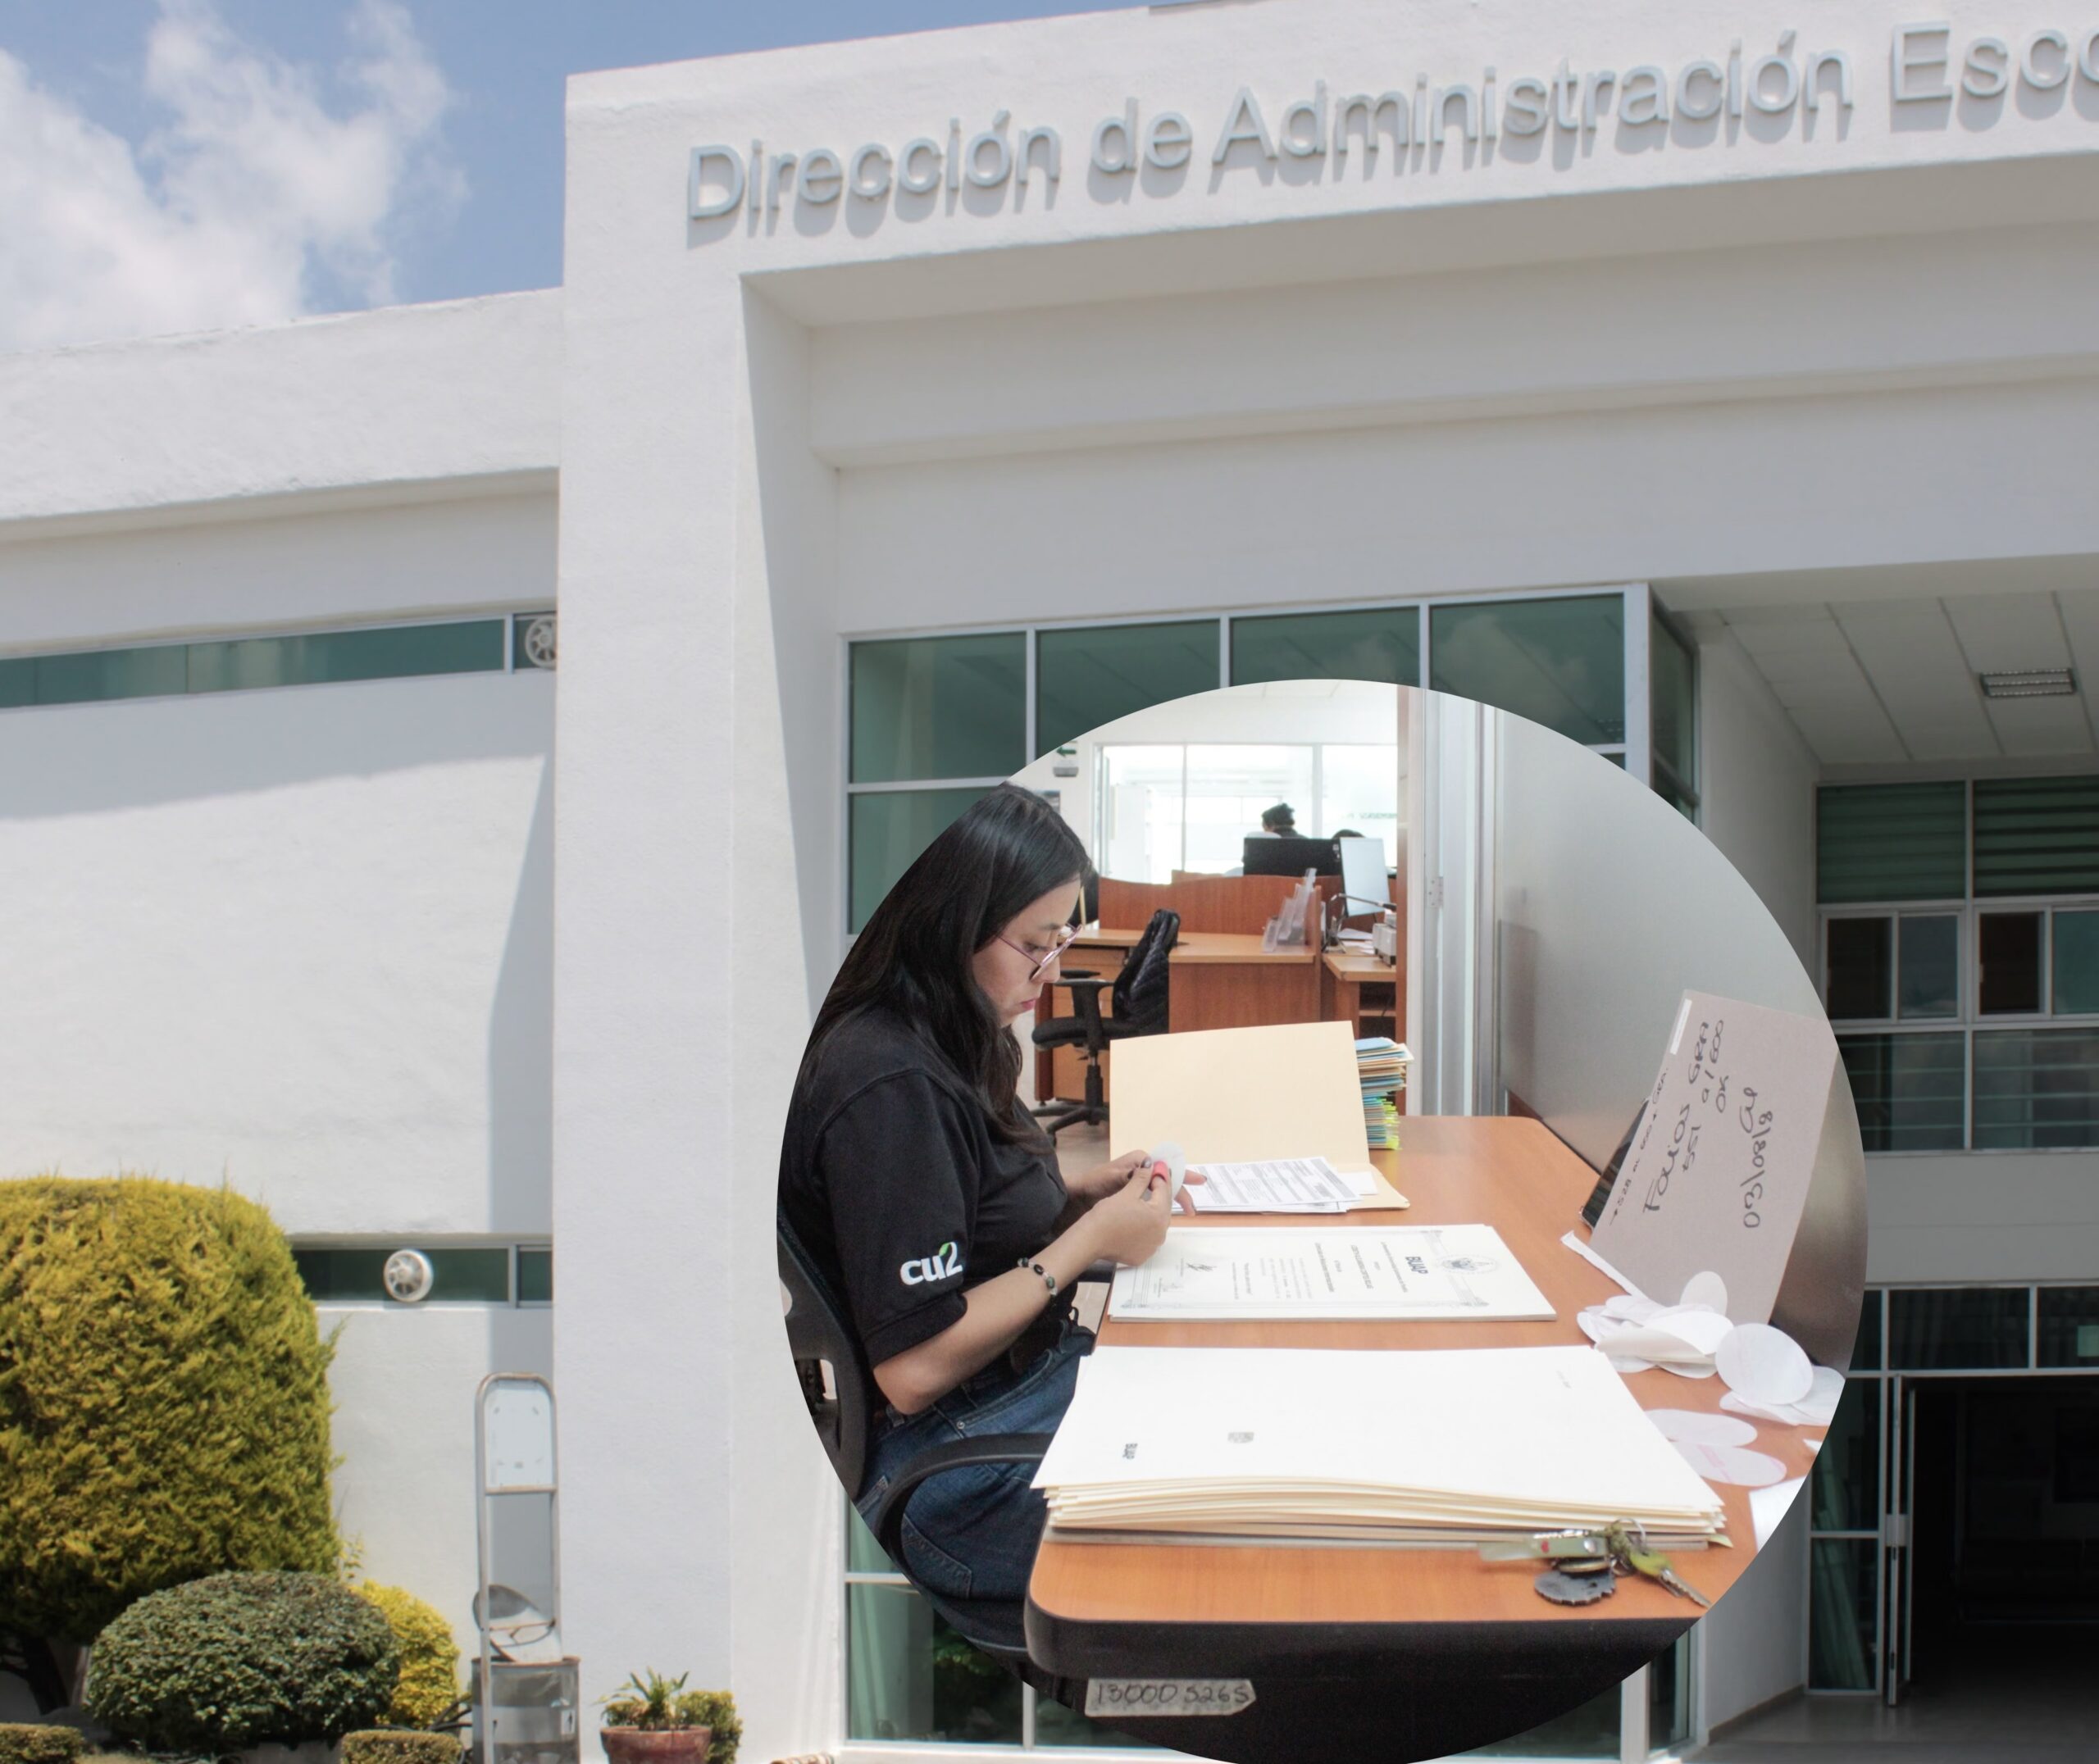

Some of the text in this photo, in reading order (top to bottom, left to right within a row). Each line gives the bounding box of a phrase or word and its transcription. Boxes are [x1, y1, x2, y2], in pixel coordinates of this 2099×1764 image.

[690, 109, 1063, 220] Dirección
[1090, 96, 1194, 174] de
[1212, 29, 1854, 165] Administración
[900, 1241, 963, 1285] cu2
[1405, 1256, 1429, 1274] BUAP
